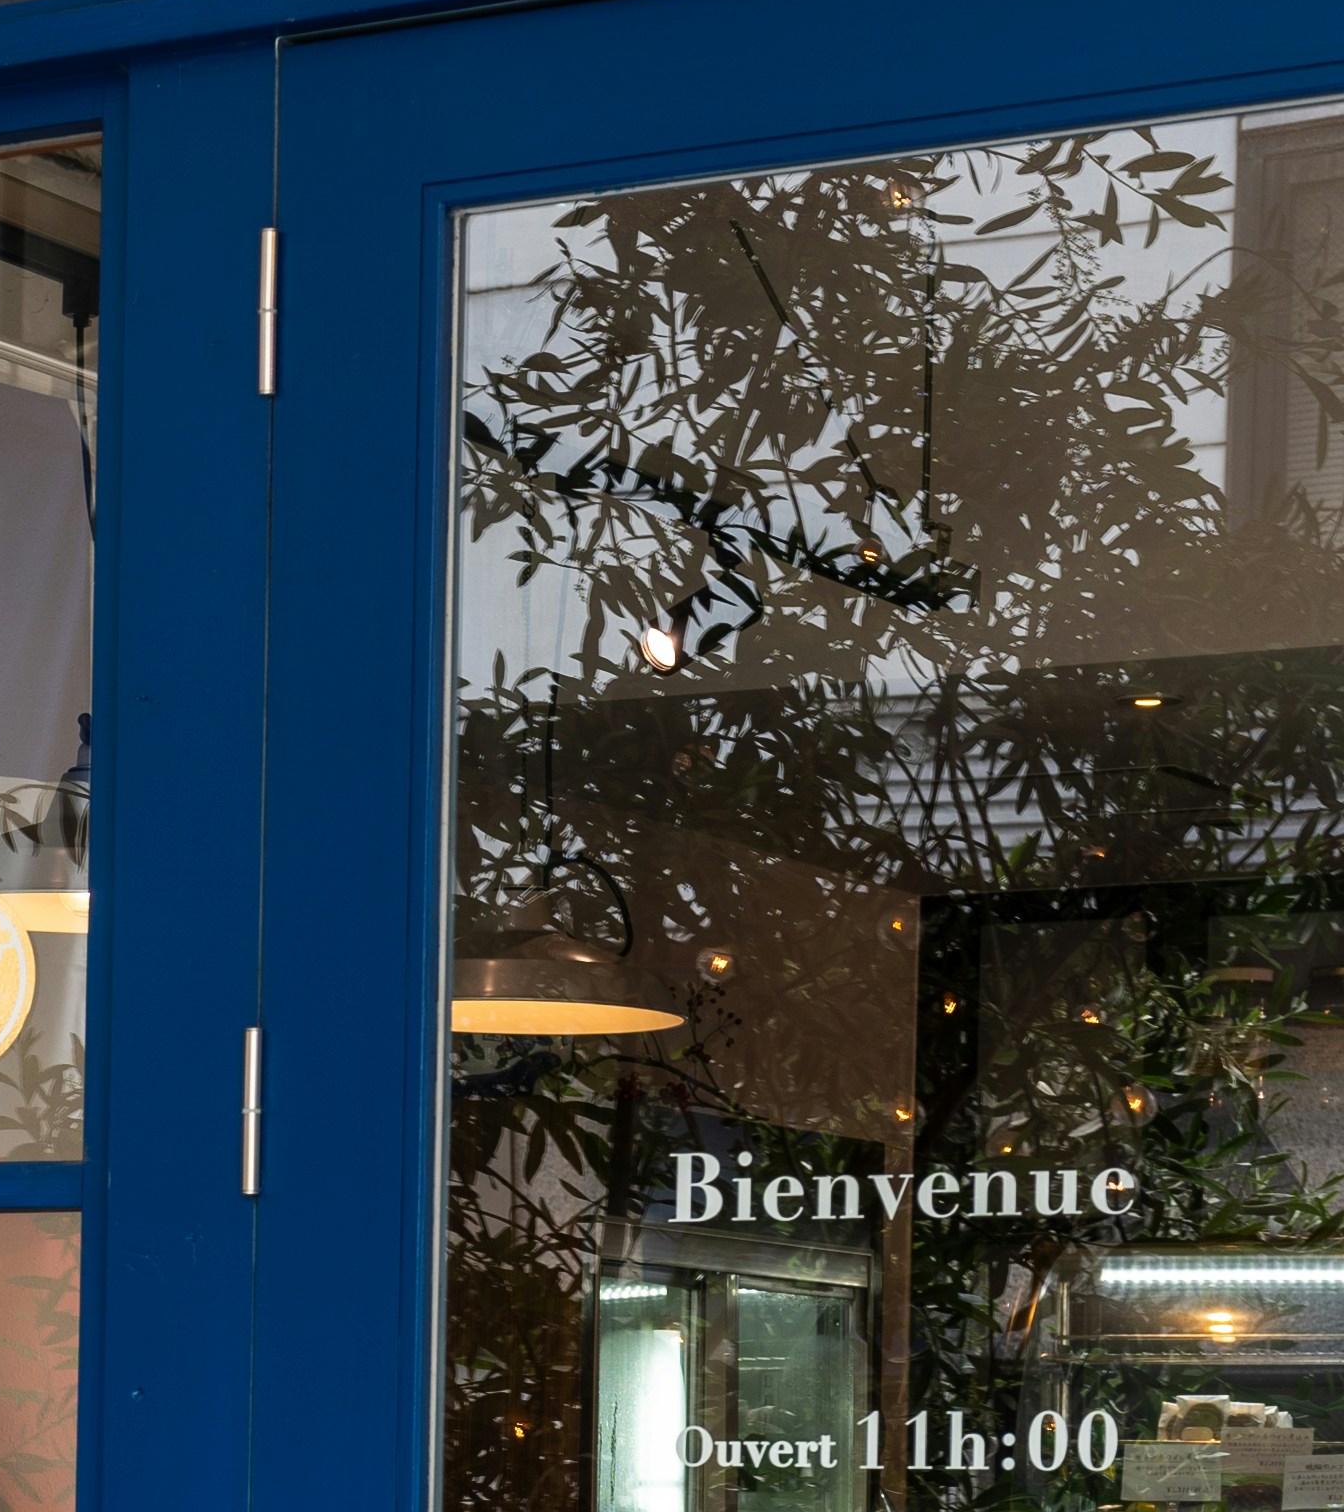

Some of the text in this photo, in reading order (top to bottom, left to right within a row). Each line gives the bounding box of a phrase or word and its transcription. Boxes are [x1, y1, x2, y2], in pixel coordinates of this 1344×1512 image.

[667, 1149, 1138, 1224] Bienvenue
[674, 1424, 839, 1470] Ouvert
[855, 1409, 1120, 1473] 11h:00
